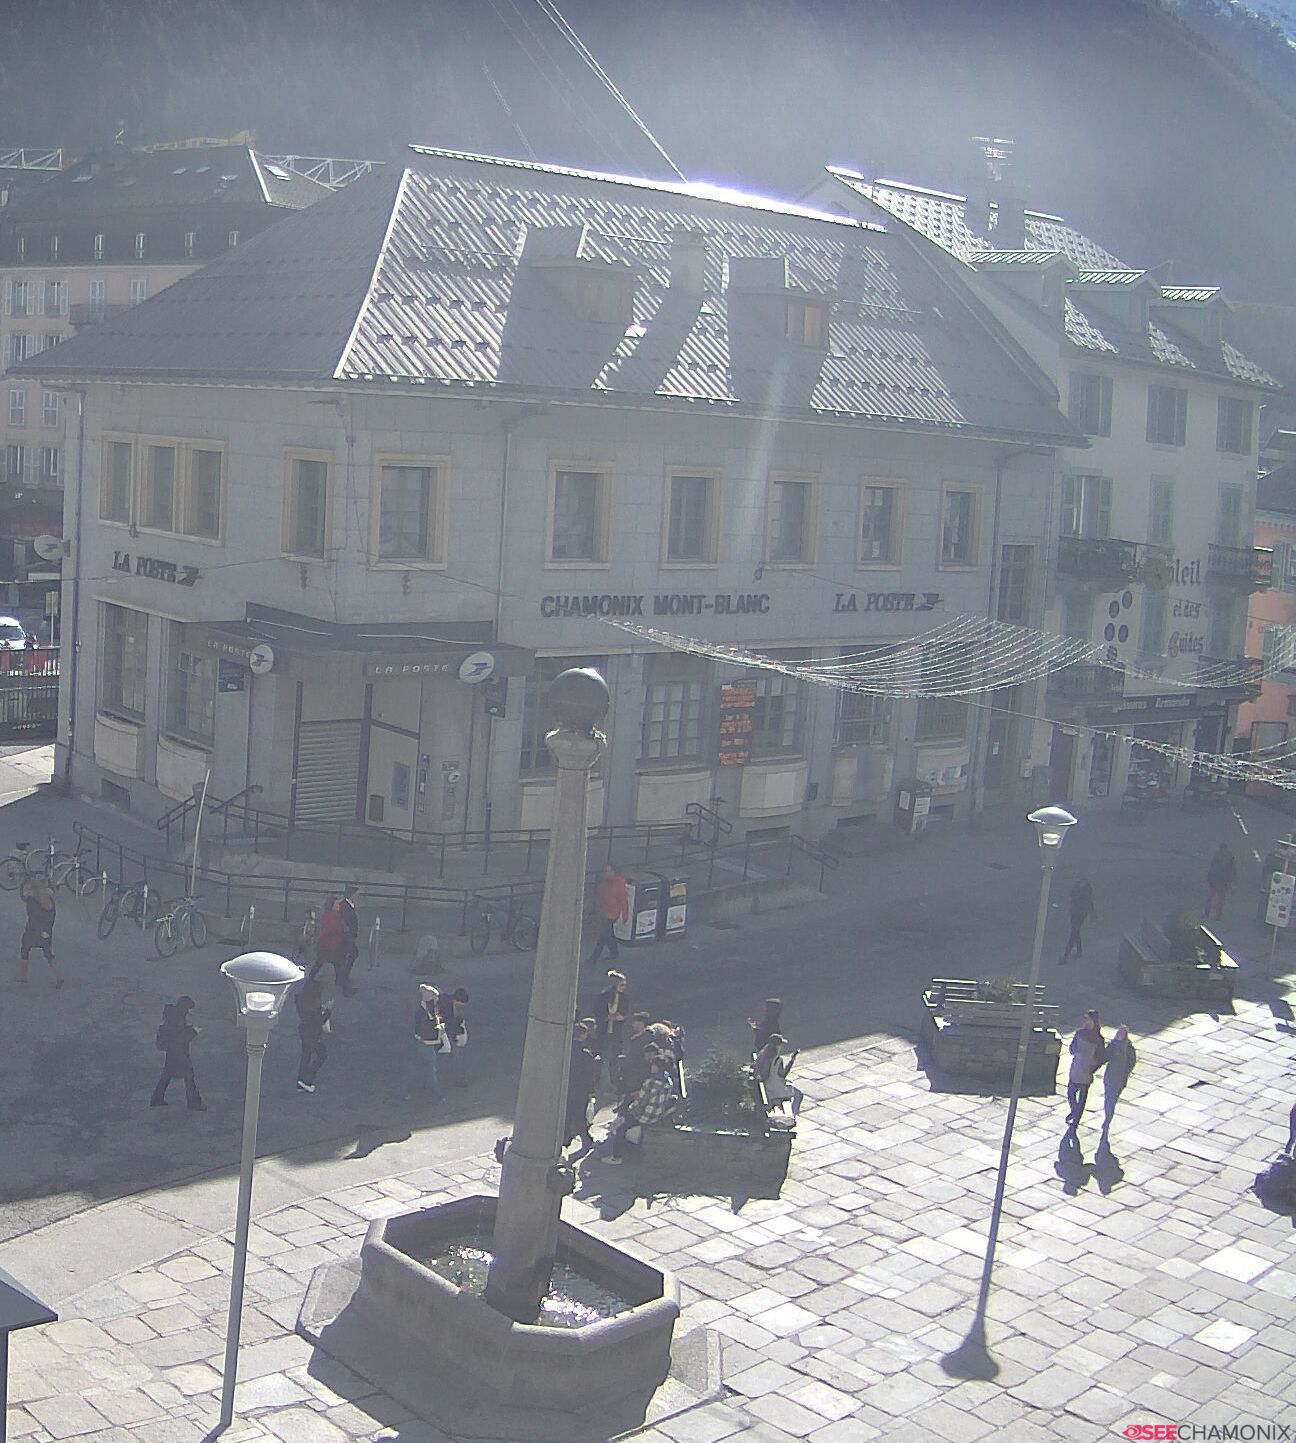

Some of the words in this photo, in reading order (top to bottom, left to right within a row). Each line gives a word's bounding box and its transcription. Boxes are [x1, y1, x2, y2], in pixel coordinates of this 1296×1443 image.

[111, 551, 131, 573] LA
[135, 556, 177, 583] POSTE
[540, 595, 644, 617] CHAMONIX
[654, 593, 770, 616] MONT-BLANC
[832, 593, 858, 611] LA
[864, 592, 915, 611] POSTE
[375, 666, 393, 674] LA
[402, 664, 449, 673] POSTE
